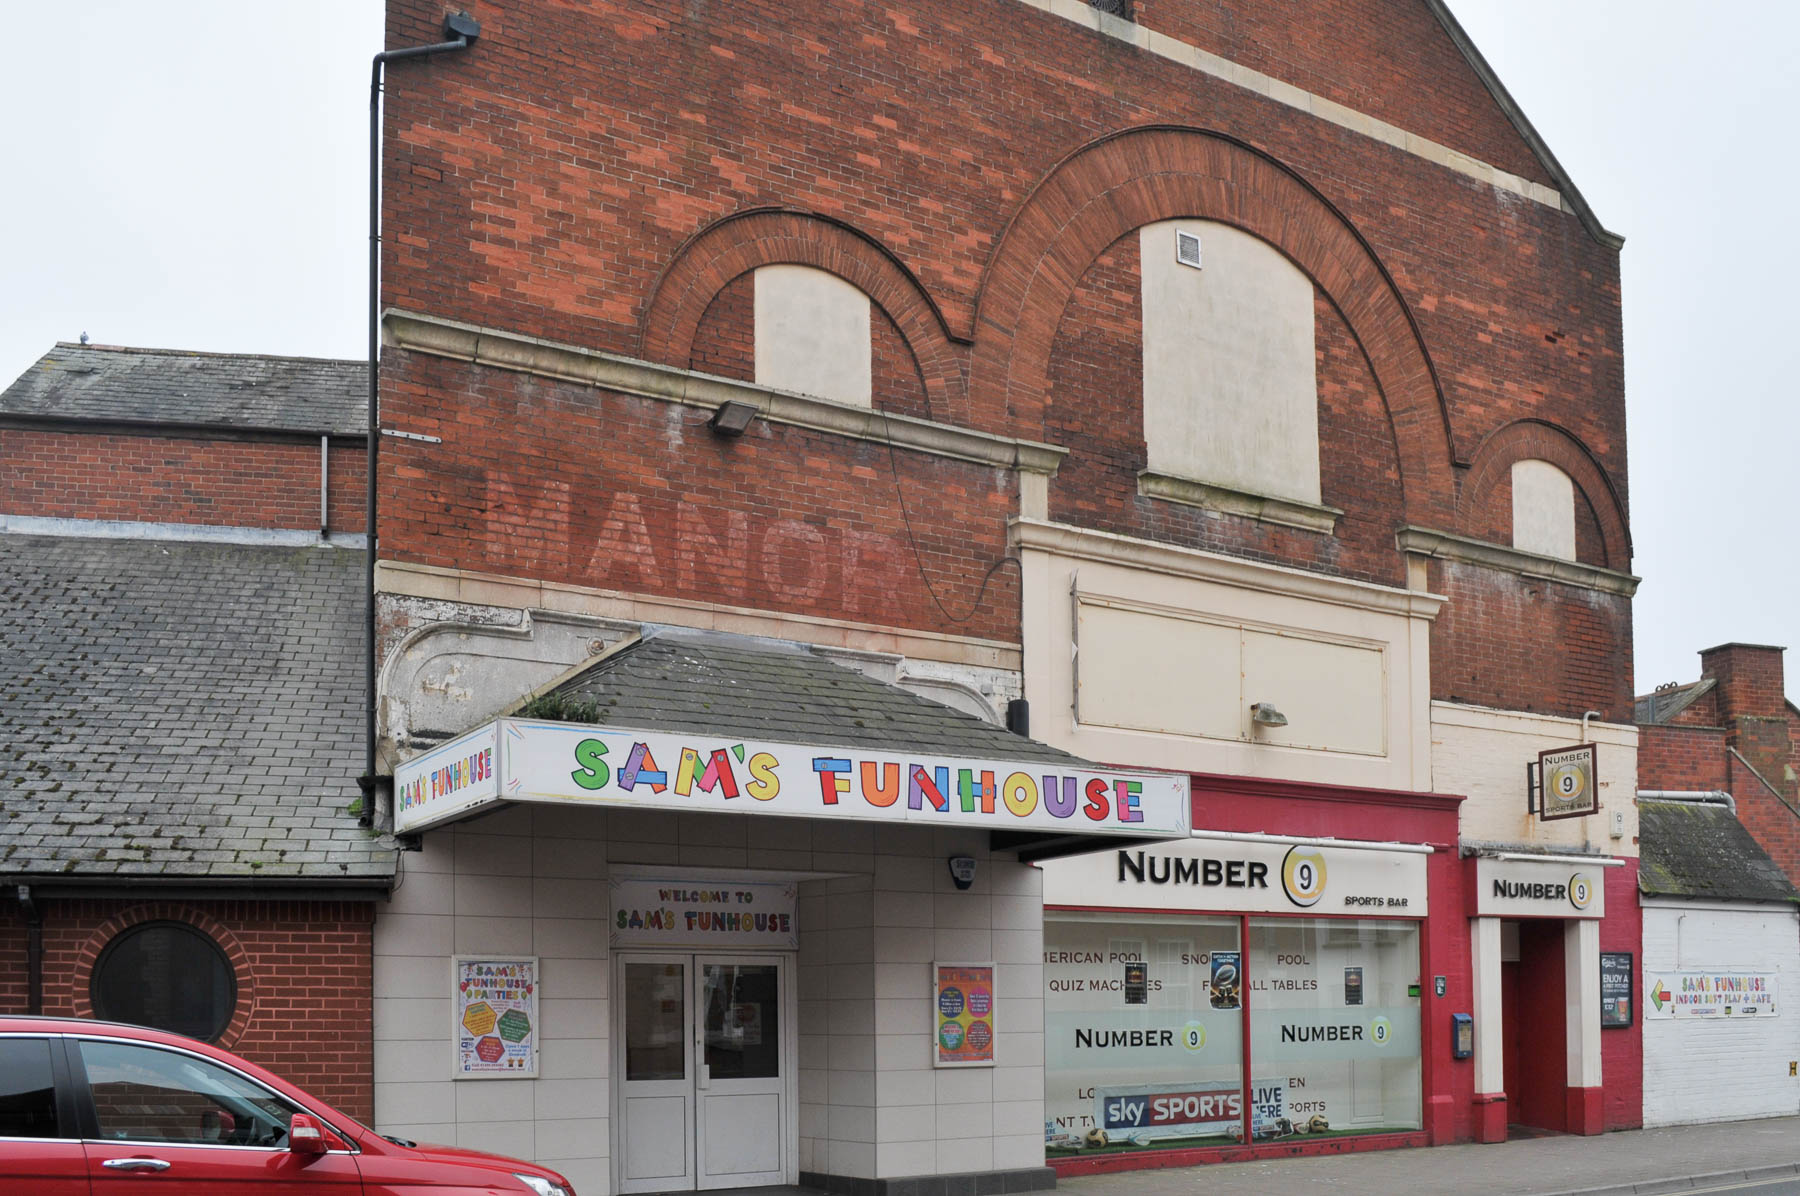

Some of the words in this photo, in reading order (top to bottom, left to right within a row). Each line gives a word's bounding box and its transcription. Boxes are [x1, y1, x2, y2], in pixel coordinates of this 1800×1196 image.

[1544, 752, 1590, 766] NUMBER
[400, 773, 426, 812] SAM'S
[432, 748, 491, 800] FUNHOUSE
[572, 739, 780, 801] SAM'S
[813, 757, 1144, 822] FUNHOUSE
[1563, 776, 1573, 792] 9
[1546, 804, 1575, 814] SPORTS
[1118, 850, 1269, 888] NUMBER
[1300, 864, 1312, 890] 9
[658, 889, 729, 903] WELCOME
[736, 892, 753, 904] TO
[1493, 879, 1567, 900] NUMBER
[1578, 884, 1585, 900] 9
[1344, 896, 1384, 906] SPORTS
[1388, 897, 1408, 907] BAR
[616, 907, 674, 930] SAM'S
[684, 912, 790, 932] FUNHOUSE
[1278, 954, 1310, 964] POOL
[476, 966, 516, 976] SAM'S
[465, 978, 528, 988] FUNHOUSE
[1272, 980, 1318, 990] TABLES
[1603, 974, 1622, 982] ENJOY
[1623, 974, 1628, 983] A
[1714, 977, 1766, 991] FUNHOUSE
[1050, 980, 1084, 992] QUIZ
[474, 990, 518, 1000] PARTIES
[1676, 994, 1702, 1004] INDOOR
[1705, 994, 1722, 1004] SOFT
[1724, 994, 1741, 1004] PLAY
[1075, 1028, 1174, 1048] NUMBER
[1190, 1031, 1198, 1046] 9
[1282, 1024, 1364, 1043] NUMBER
[1377, 1025, 1385, 1040] 9
[1251, 1088, 1282, 1104] LIVE
[1109, 1098, 1144, 1126] sky
[1153, 1093, 1240, 1120] SPORTS
[1290, 1102, 1326, 1112] PORTS
